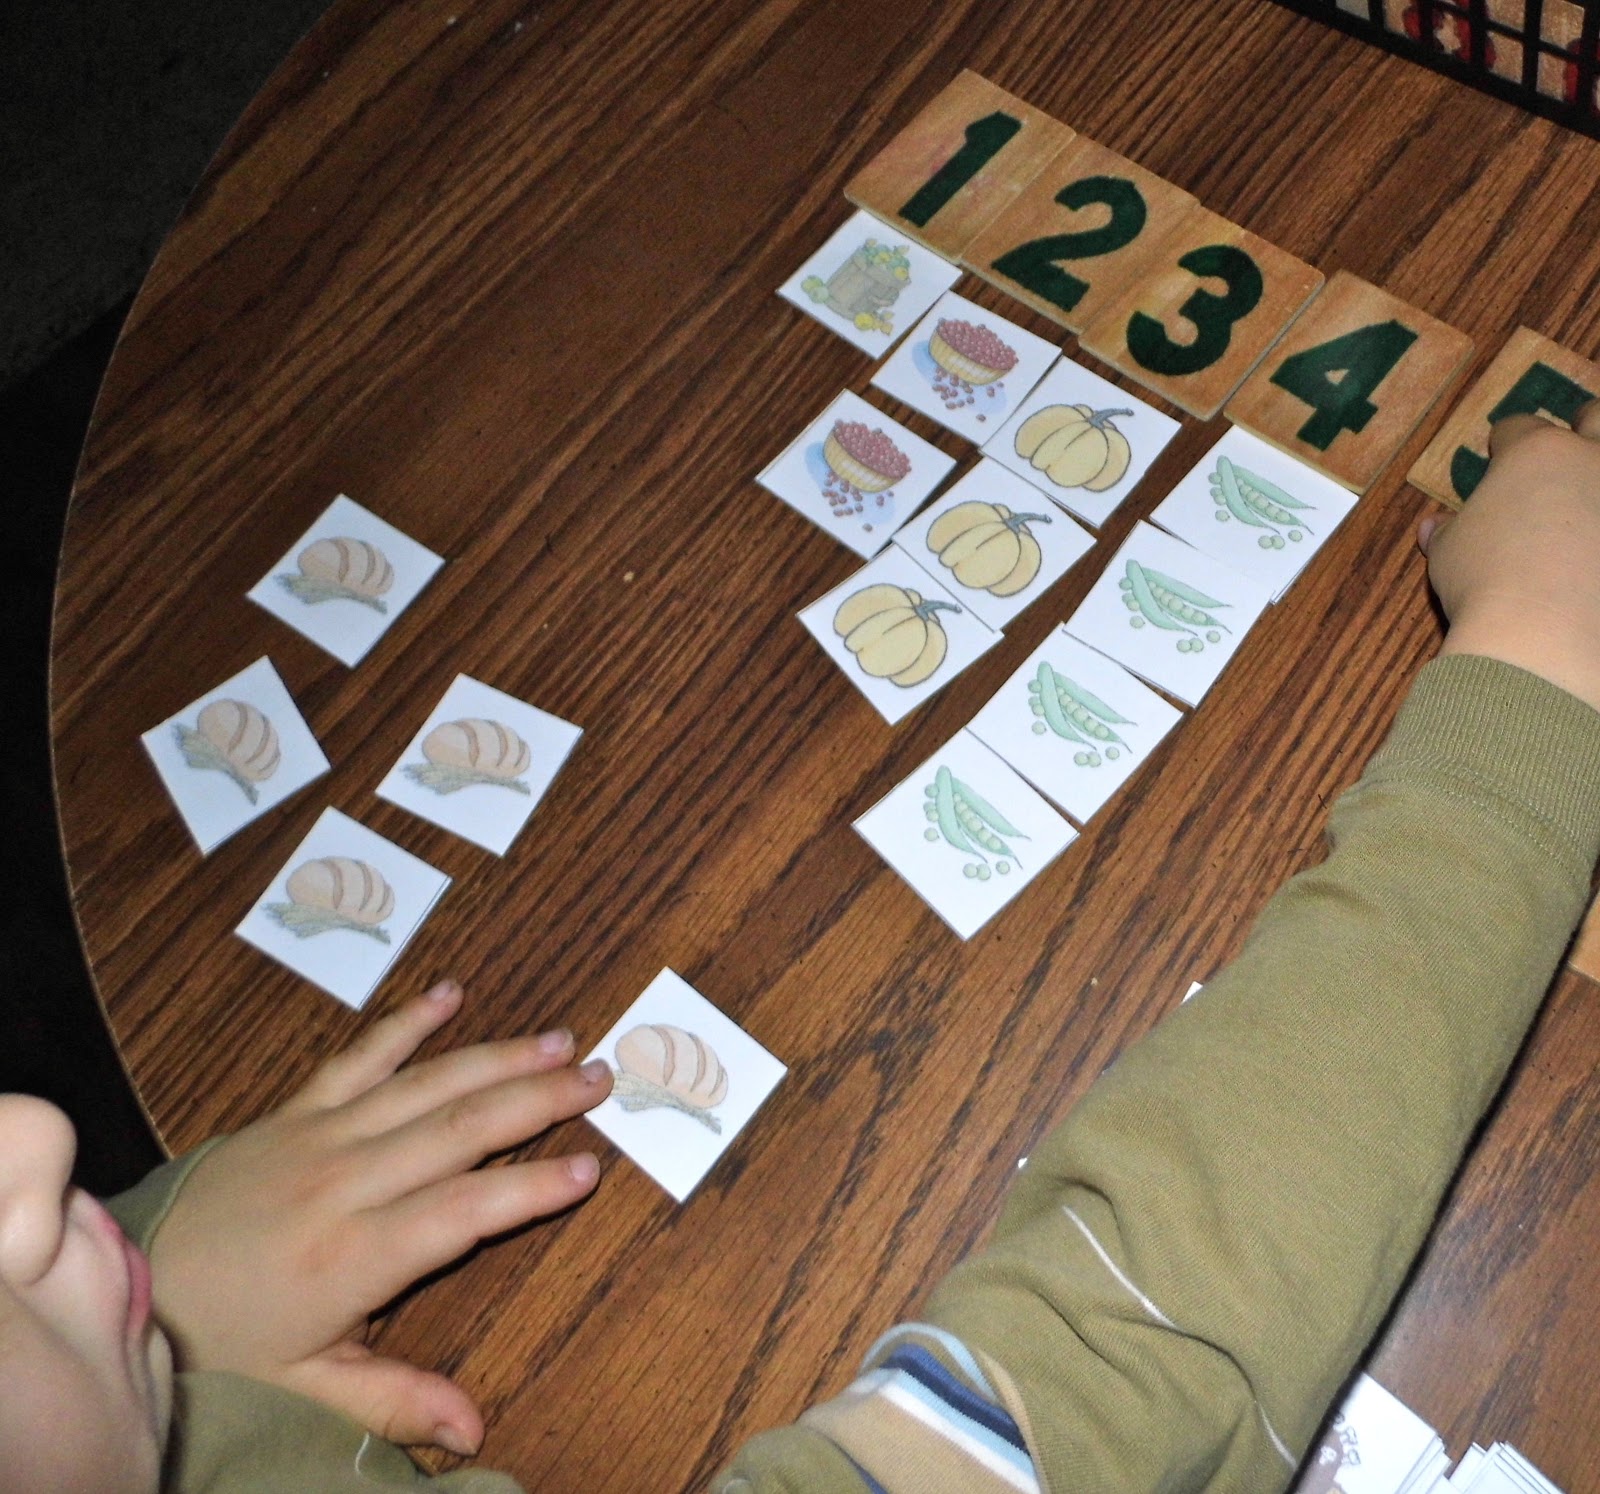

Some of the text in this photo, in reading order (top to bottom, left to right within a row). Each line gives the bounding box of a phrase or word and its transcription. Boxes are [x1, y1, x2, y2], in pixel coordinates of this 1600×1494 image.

[898, 110, 1022, 228] 1
[991, 176, 1147, 312] 2
[1127, 244, 1263, 376] 3
[1269, 319, 1419, 452] 4
